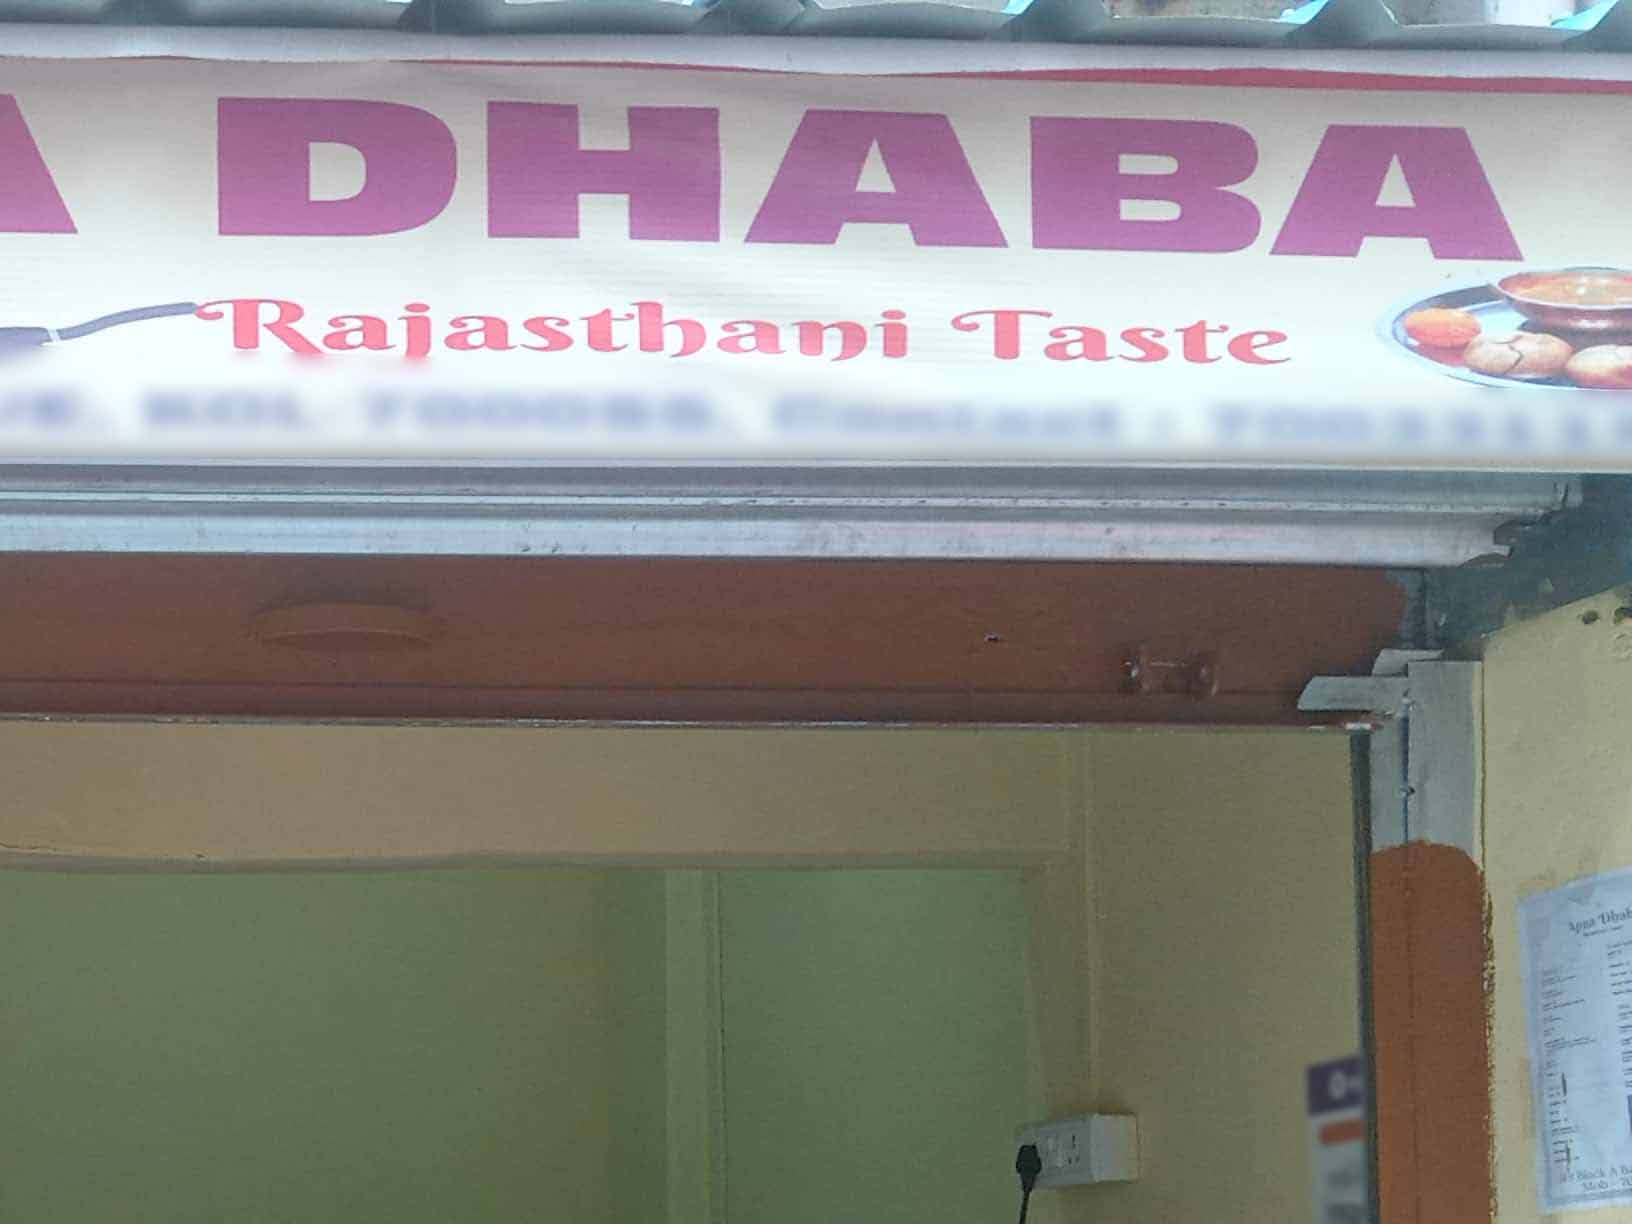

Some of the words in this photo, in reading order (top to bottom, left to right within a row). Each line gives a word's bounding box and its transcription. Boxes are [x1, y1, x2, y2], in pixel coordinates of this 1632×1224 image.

[217, 97, 1525, 261] DHABA
[196, 298, 908, 362] Rajasthani
[951, 309, 1291, 365] Taste
[1597, 907, 1632, 926] Dhab
